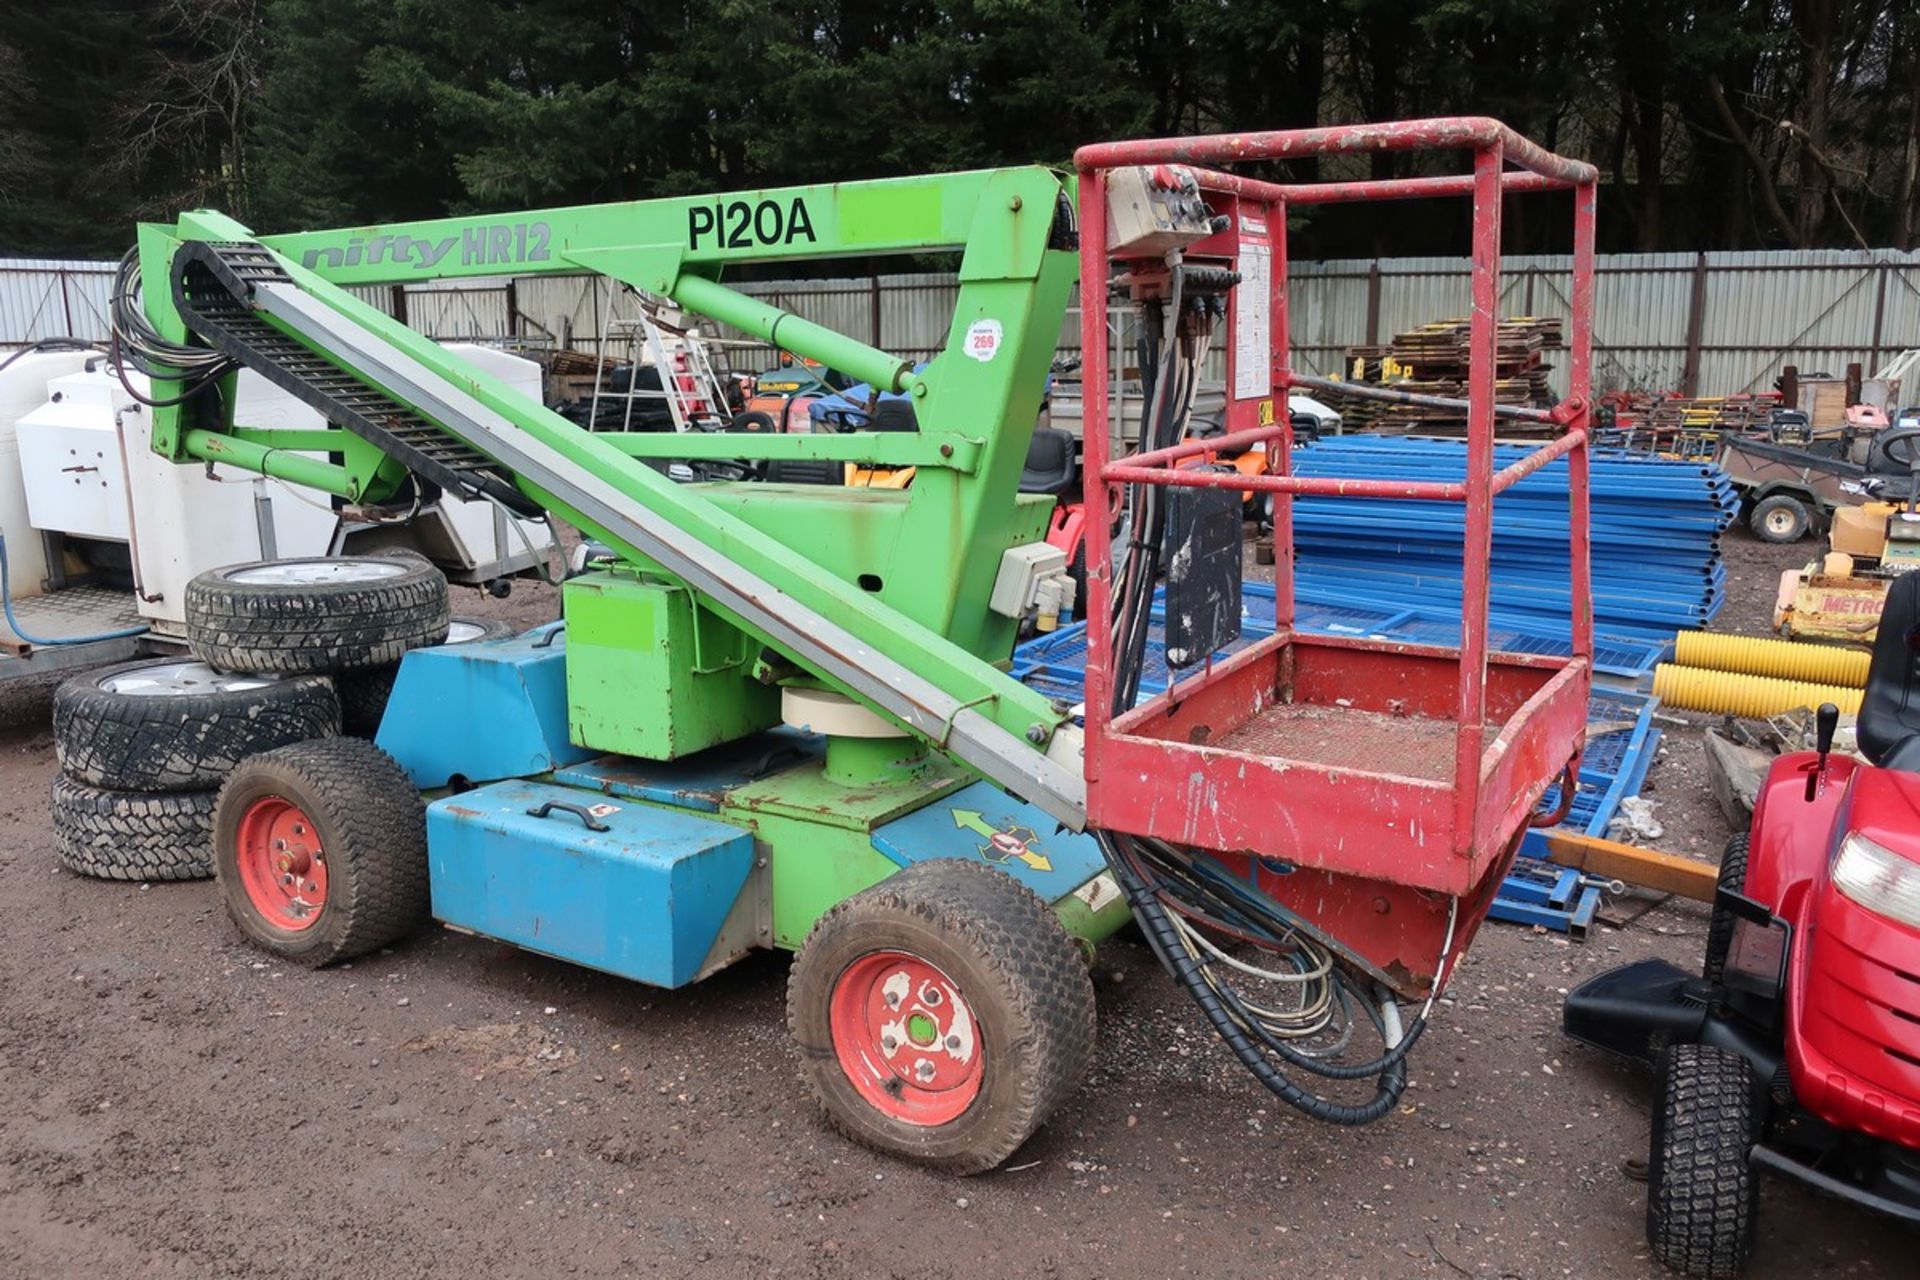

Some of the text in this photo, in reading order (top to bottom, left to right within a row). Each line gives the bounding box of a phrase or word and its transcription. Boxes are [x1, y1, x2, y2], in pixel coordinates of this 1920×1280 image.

[302, 222, 551, 269] nifty HR12
[974, 335, 994, 349] 269
